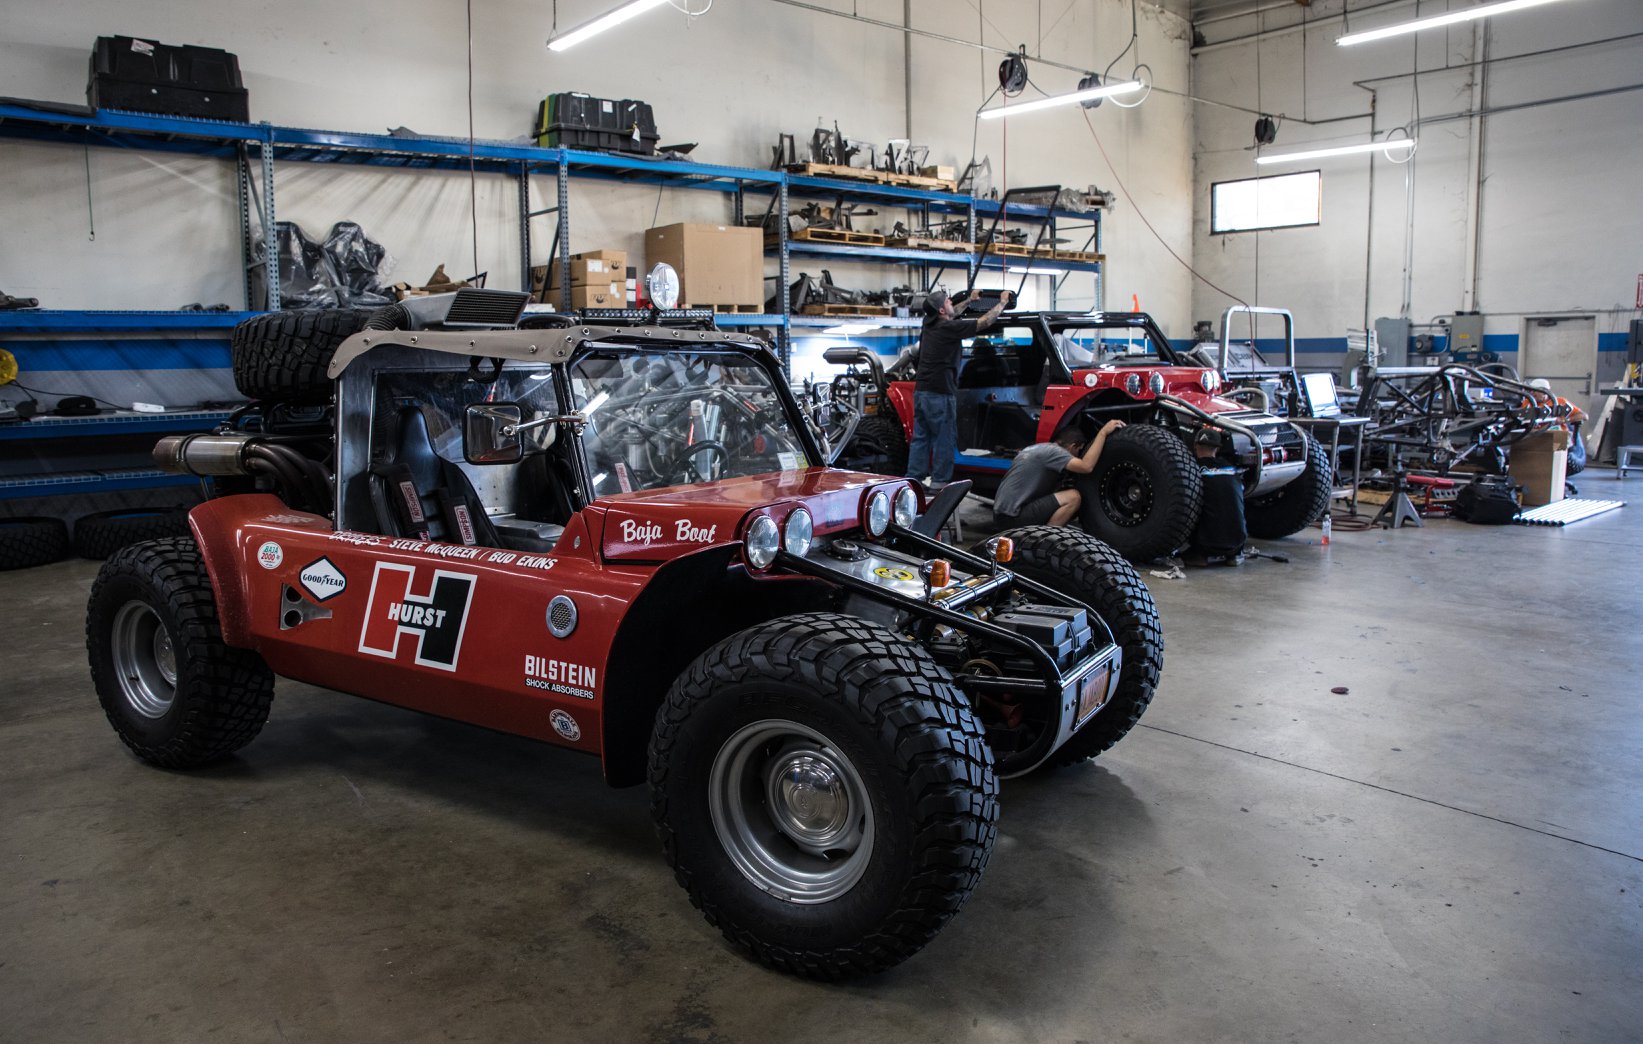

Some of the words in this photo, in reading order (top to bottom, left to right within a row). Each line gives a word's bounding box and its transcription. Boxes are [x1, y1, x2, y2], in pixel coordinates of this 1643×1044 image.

[458, 510, 472, 540] SIMPSON
[620, 519, 663, 546] Baja
[675, 518, 717, 544] Boot
[261, 552, 276, 561] 2000
[263, 546, 279, 554] BAJA
[388, 539, 427, 552] STEVE
[424, 543, 481, 559] McQUEEN
[488, 551, 517, 564] BUD
[516, 555, 559, 570] EKINS
[387, 602, 447, 628] HURST
[524, 654, 597, 689] BILSTEIN
[525, 678, 550, 690] SHOCK
[551, 684, 594, 700] ABSORBERS
